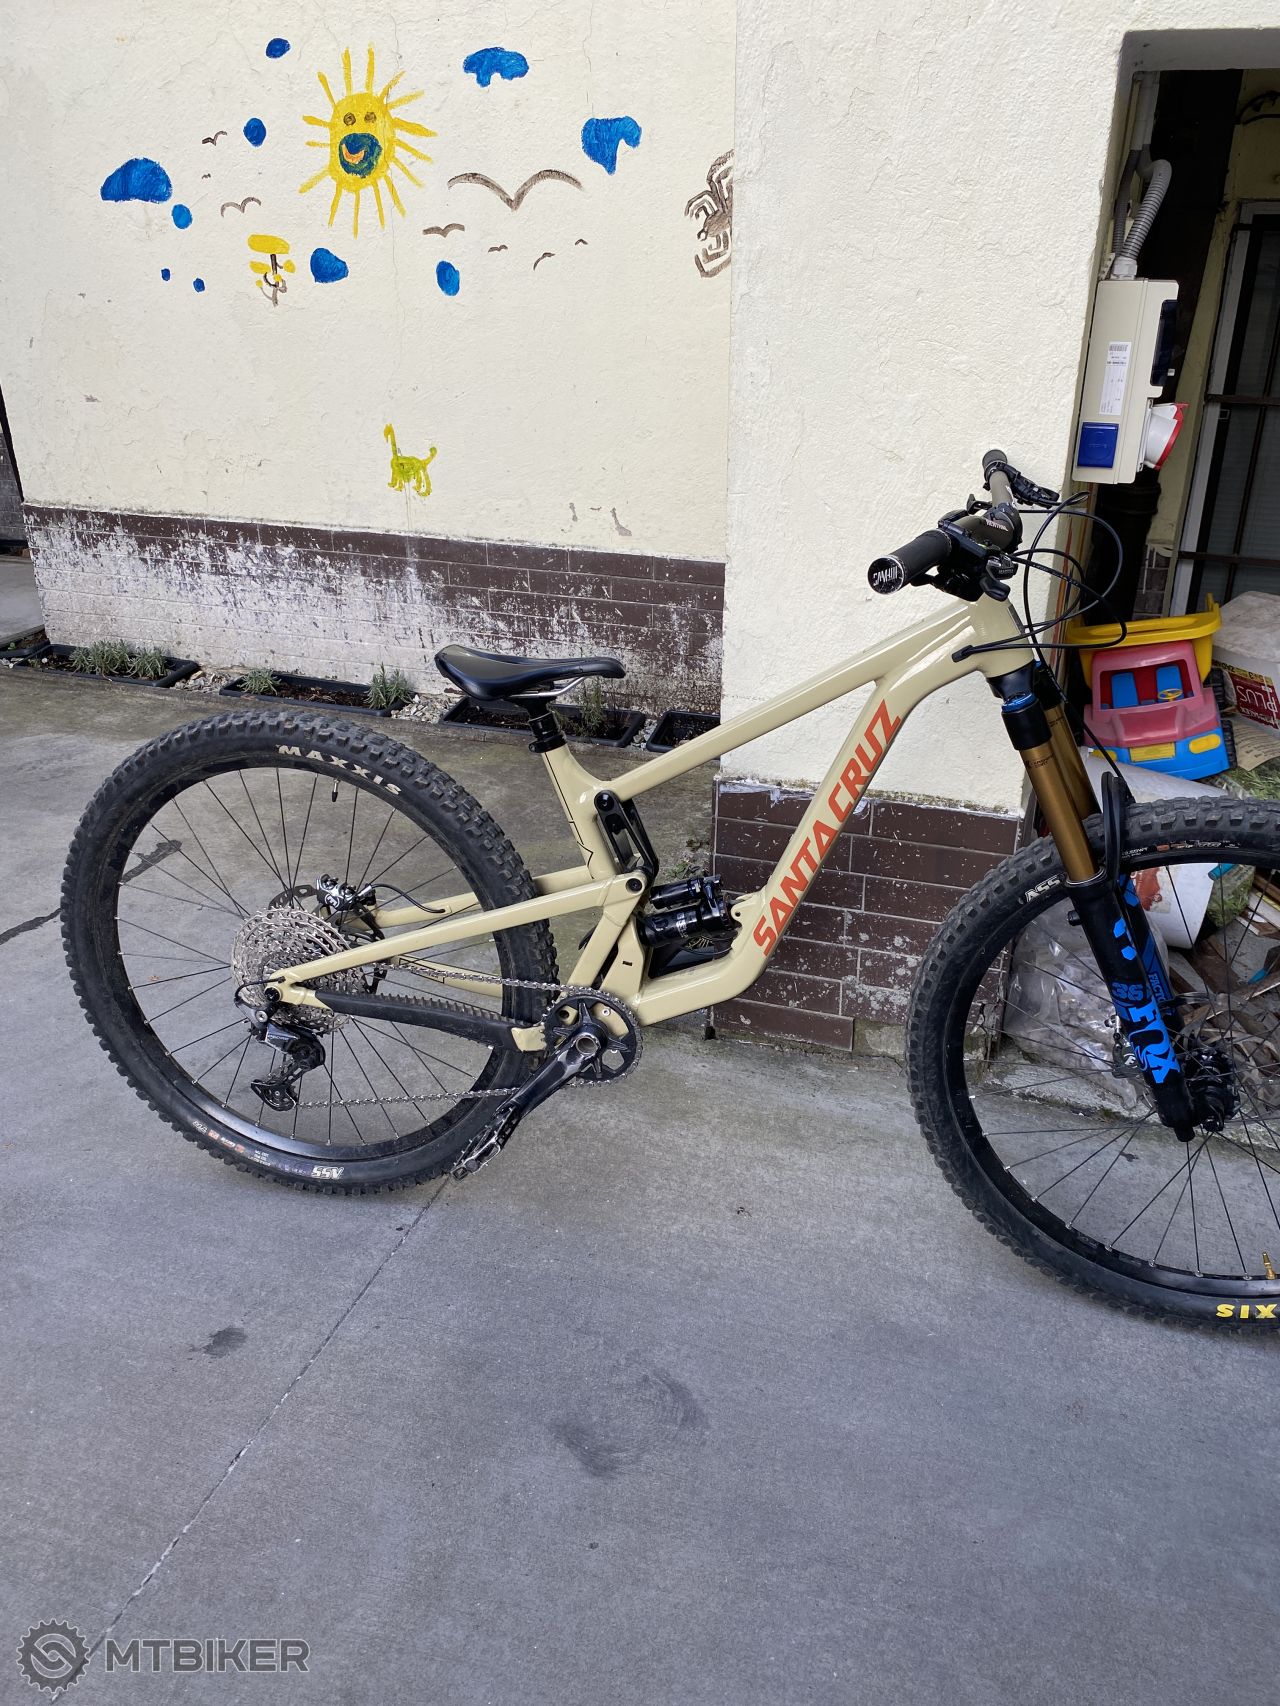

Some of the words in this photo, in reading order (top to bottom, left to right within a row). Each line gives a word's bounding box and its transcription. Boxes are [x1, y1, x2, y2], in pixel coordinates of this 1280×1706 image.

[276, 744, 402, 795] MAXXIS
[753, 819, 838, 957] SANTA
[828, 699, 901, 823] CRUZ
[1111, 982, 1144, 1001] 36
[1128, 1000, 1181, 1084] FOX
